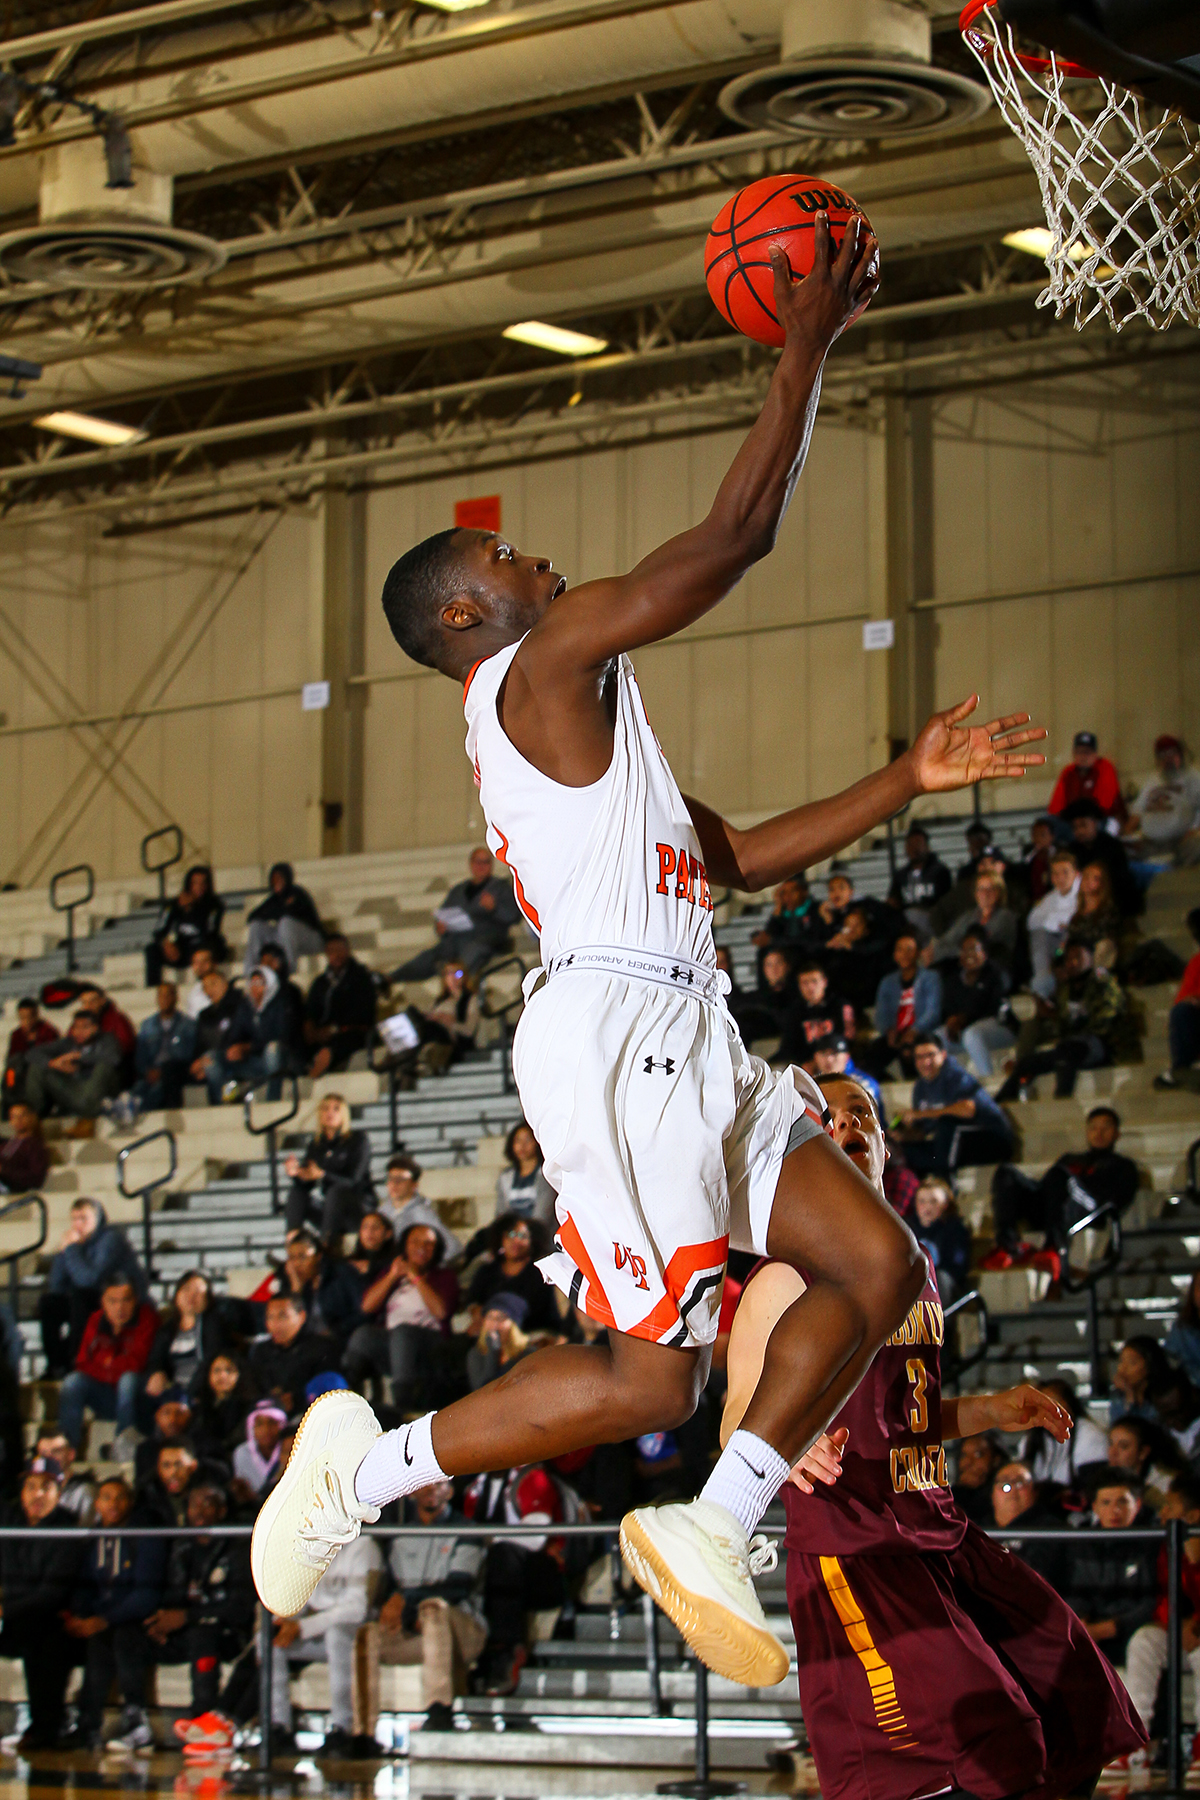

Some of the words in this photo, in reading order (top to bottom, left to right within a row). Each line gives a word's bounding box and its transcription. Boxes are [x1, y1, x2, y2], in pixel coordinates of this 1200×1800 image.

[577, 953, 624, 965] ARMOUR
[627, 959, 667, 975] UNDER
[906, 1358, 928, 1434] 3
